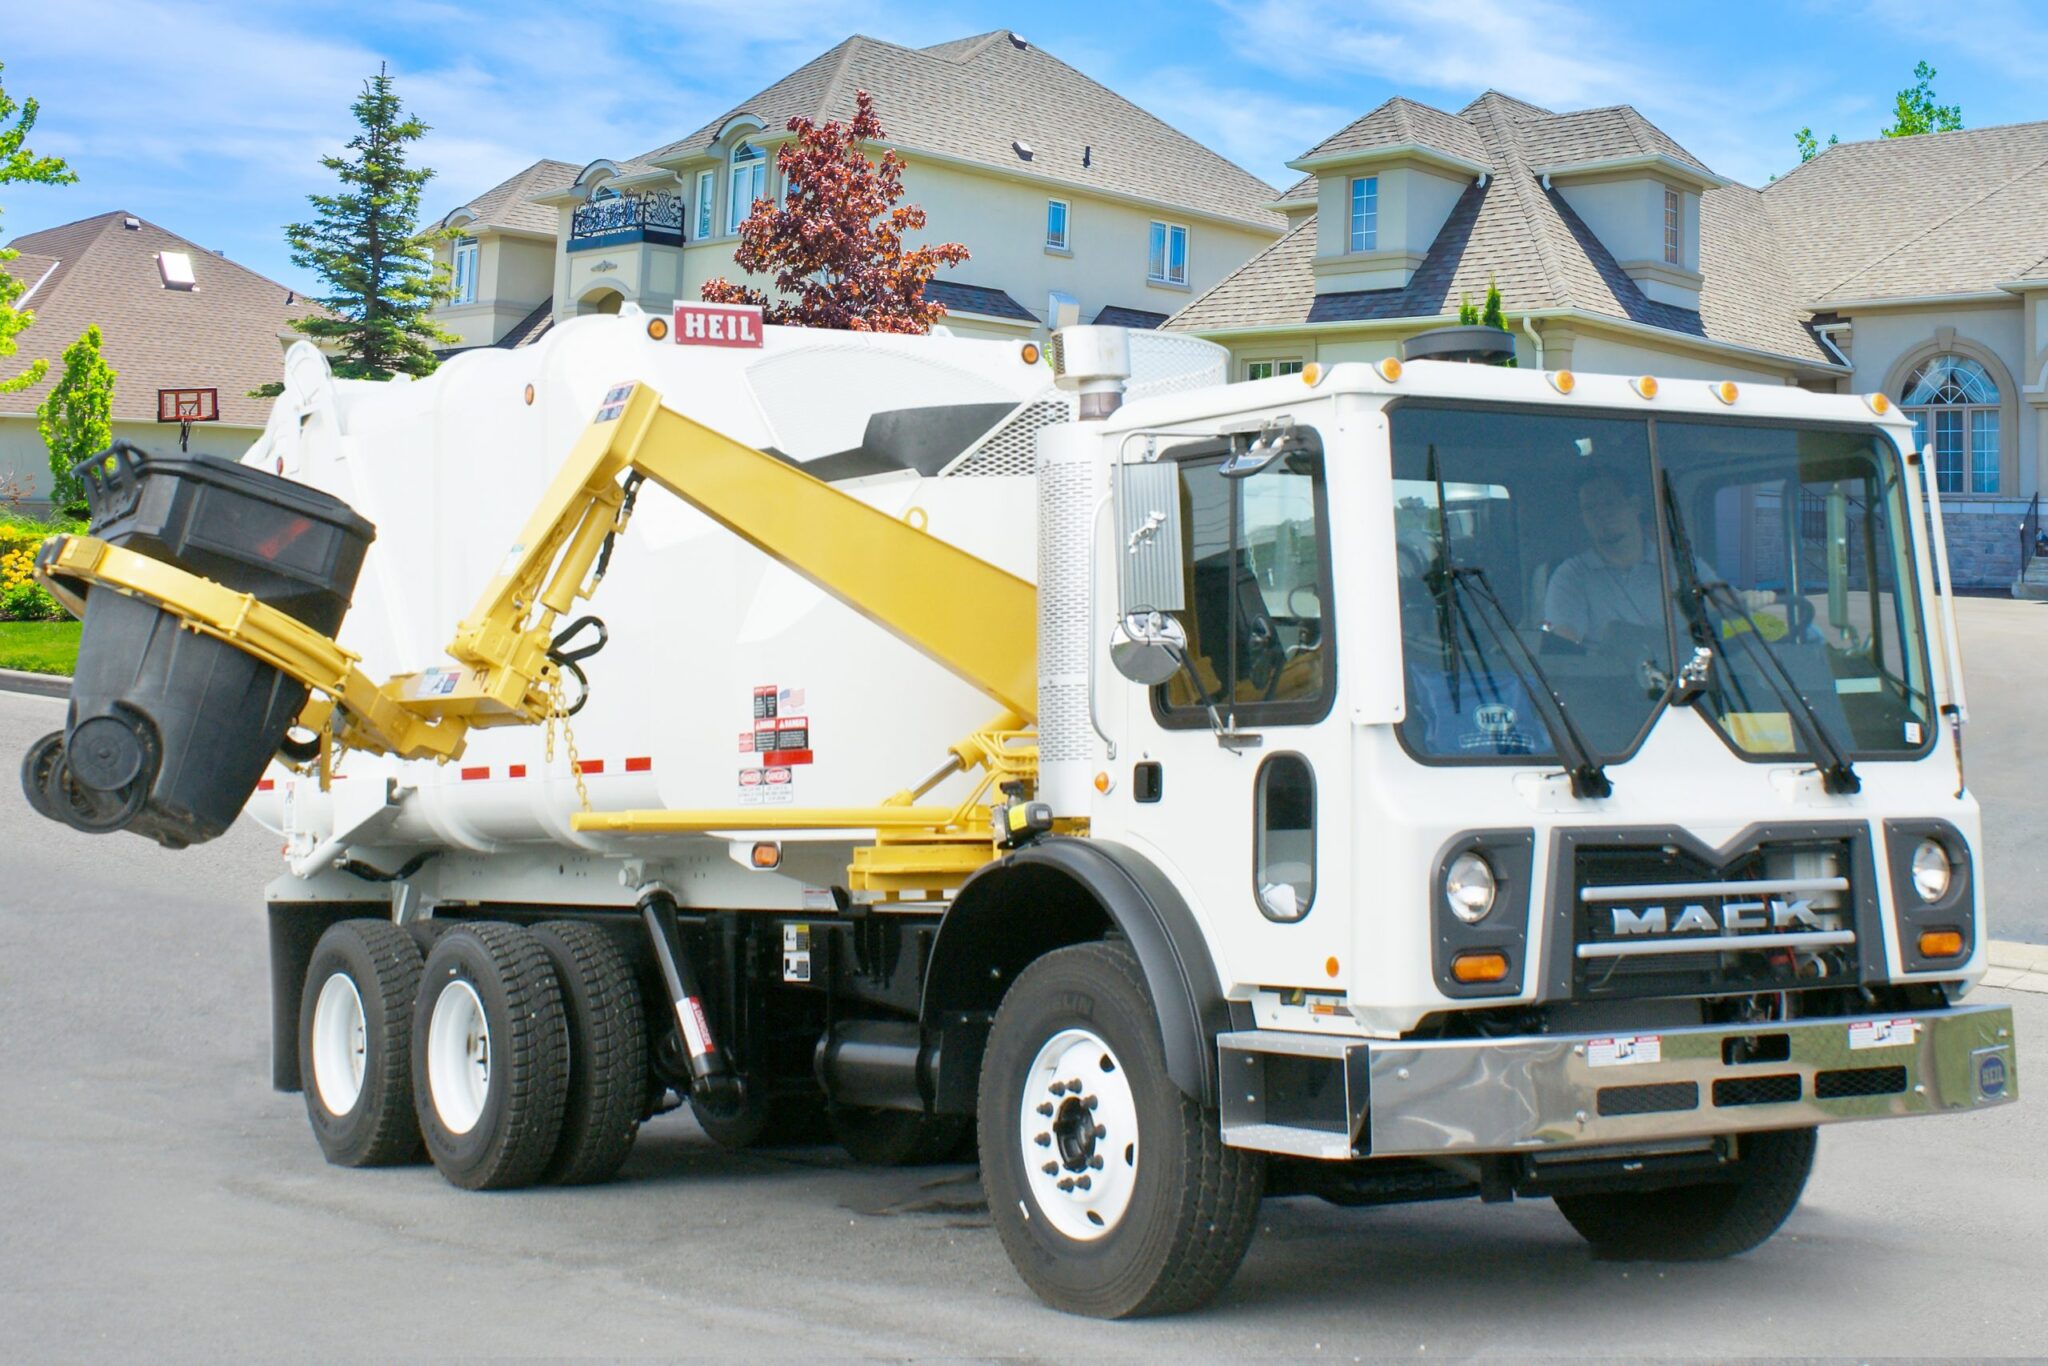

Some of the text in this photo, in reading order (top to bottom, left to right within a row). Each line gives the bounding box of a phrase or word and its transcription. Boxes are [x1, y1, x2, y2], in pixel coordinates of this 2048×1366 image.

[684, 312, 756, 342] HEIL
[1480, 711, 1513, 724] HEIL
[1611, 899, 1823, 936] MACK
